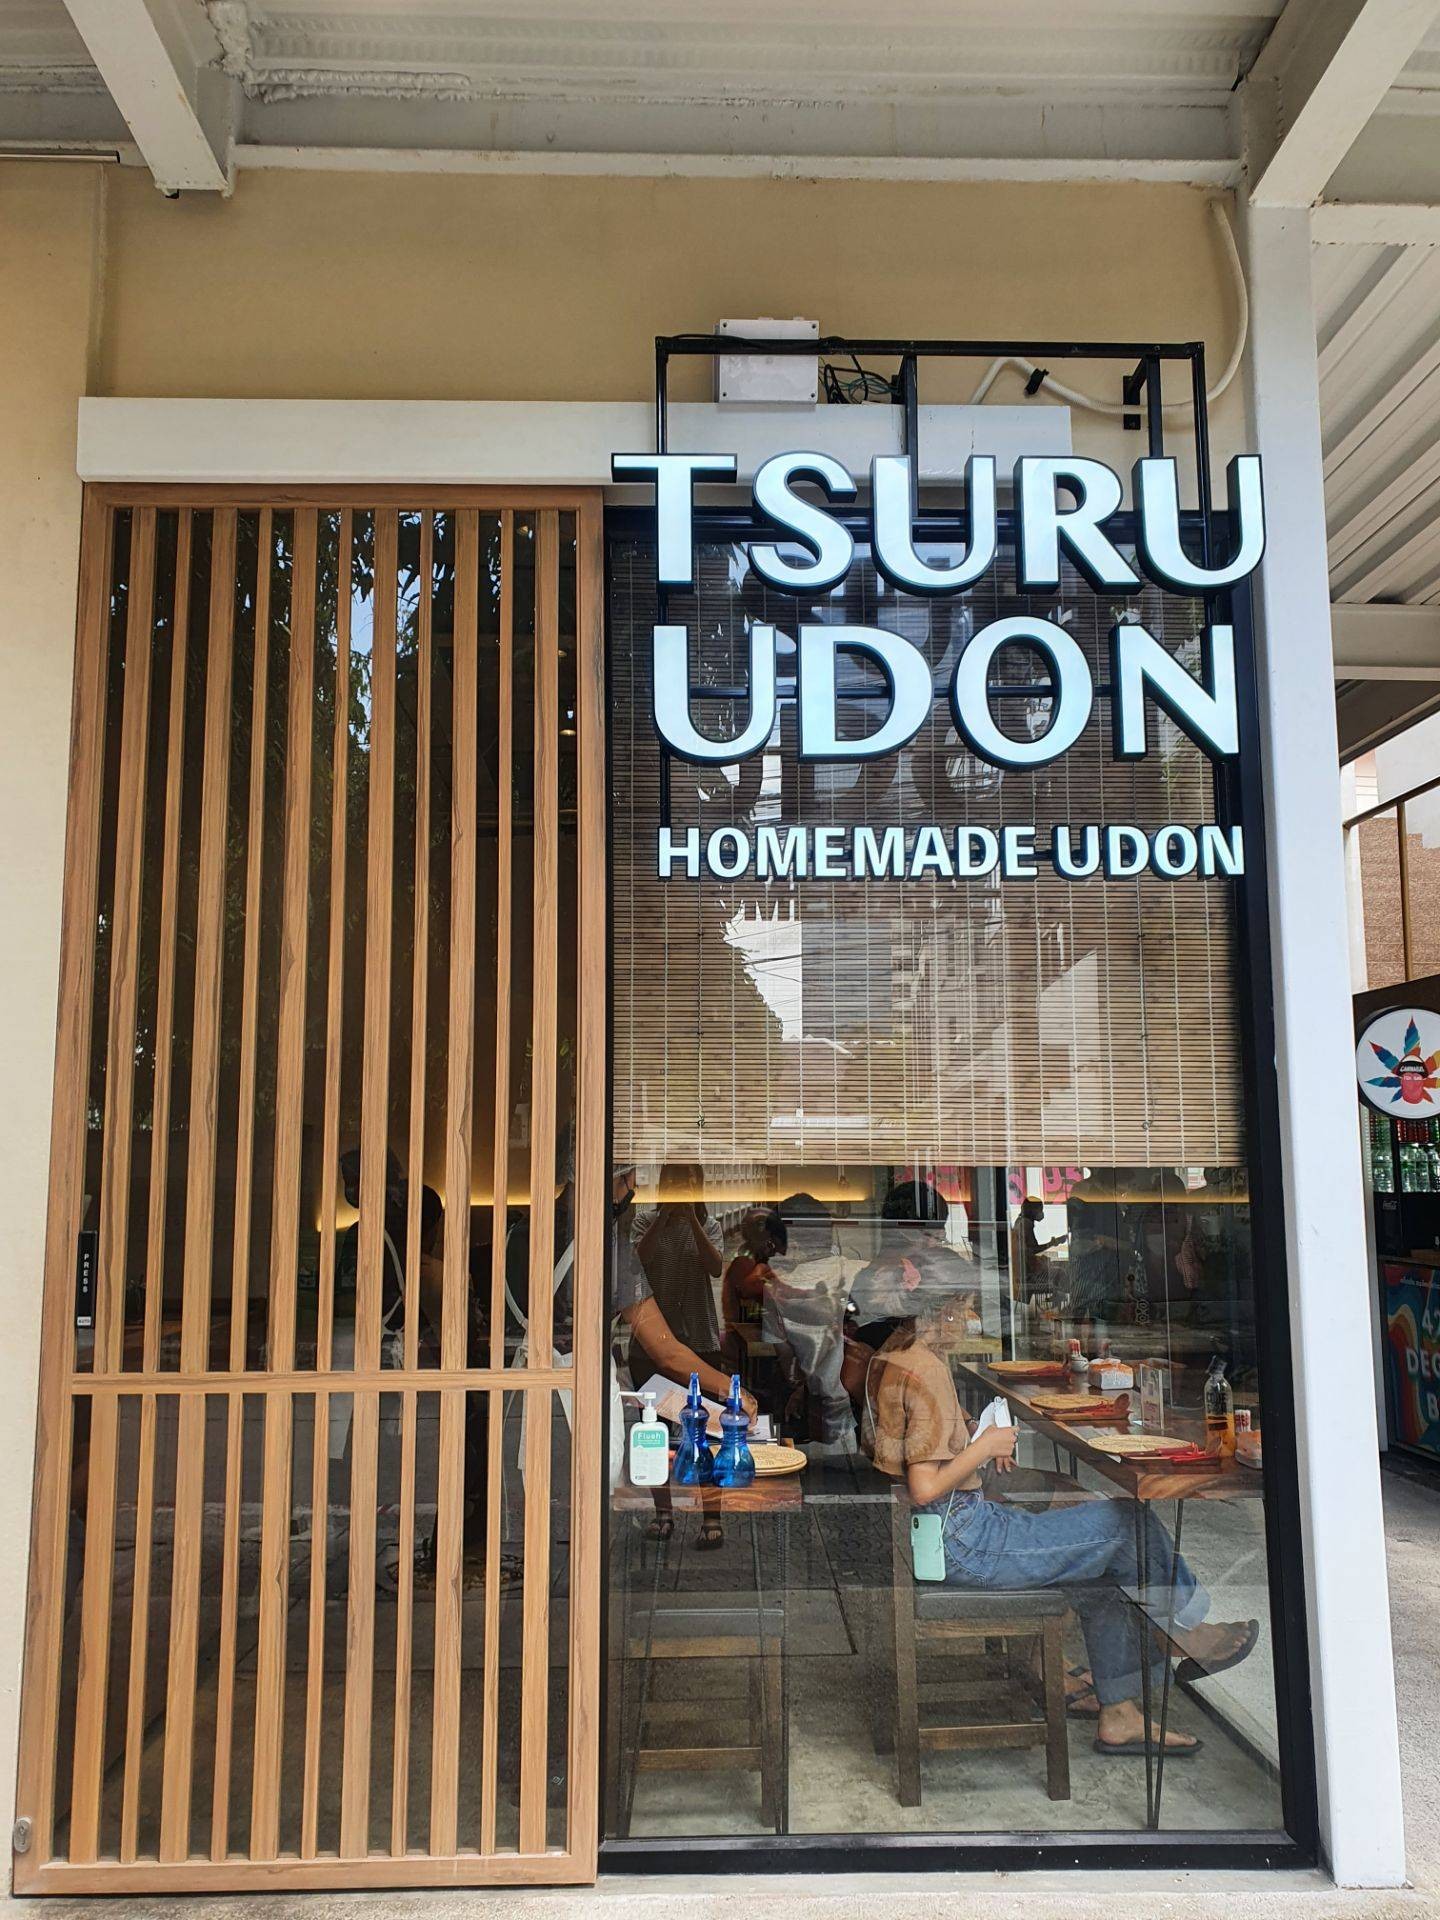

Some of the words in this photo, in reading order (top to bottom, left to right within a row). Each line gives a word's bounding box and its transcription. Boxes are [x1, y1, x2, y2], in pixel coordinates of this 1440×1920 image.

[612, 452, 1266, 595] TSURU
[652, 616, 1242, 770] UDON
[657, 825, 1038, 881] HOMEMADE
[1053, 824, 1246, 880] UDON
[82, 1253, 90, 1293] PRESS
